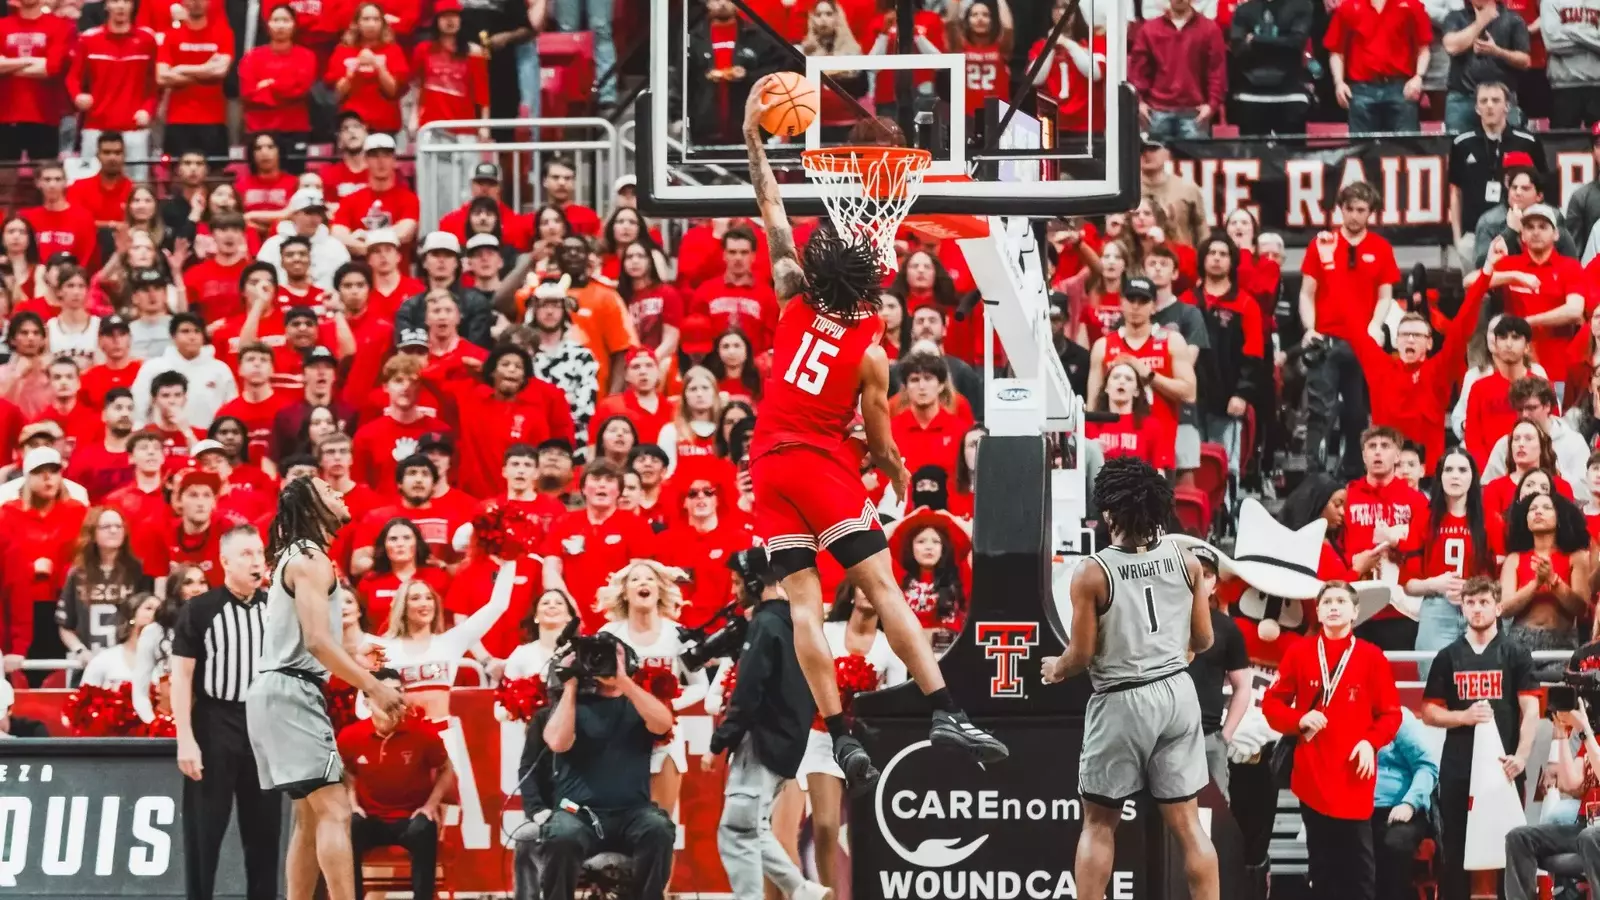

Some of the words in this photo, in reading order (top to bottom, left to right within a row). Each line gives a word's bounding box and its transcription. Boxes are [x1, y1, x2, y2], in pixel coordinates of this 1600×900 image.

[966, 63, 997, 90] 22
[1059, 61, 1069, 99] 1
[1164, 158, 1260, 226] HE
[1284, 155, 1452, 227] RAID
[811, 313, 847, 341] TOPPIN
[783, 331, 841, 396] 15
[1117, 560, 1161, 581] WRIGHT
[1444, 538, 1465, 579] 9
[89, 603, 118, 647] 5
[1143, 585, 1160, 635] 1
[400, 662, 449, 685] ECH
[1453, 670, 1503, 700] TECH
[891, 789, 1137, 820] CAREnoms
[0, 796, 175, 887] QUIS
[879, 870, 1134, 900] WOUNDCAE
